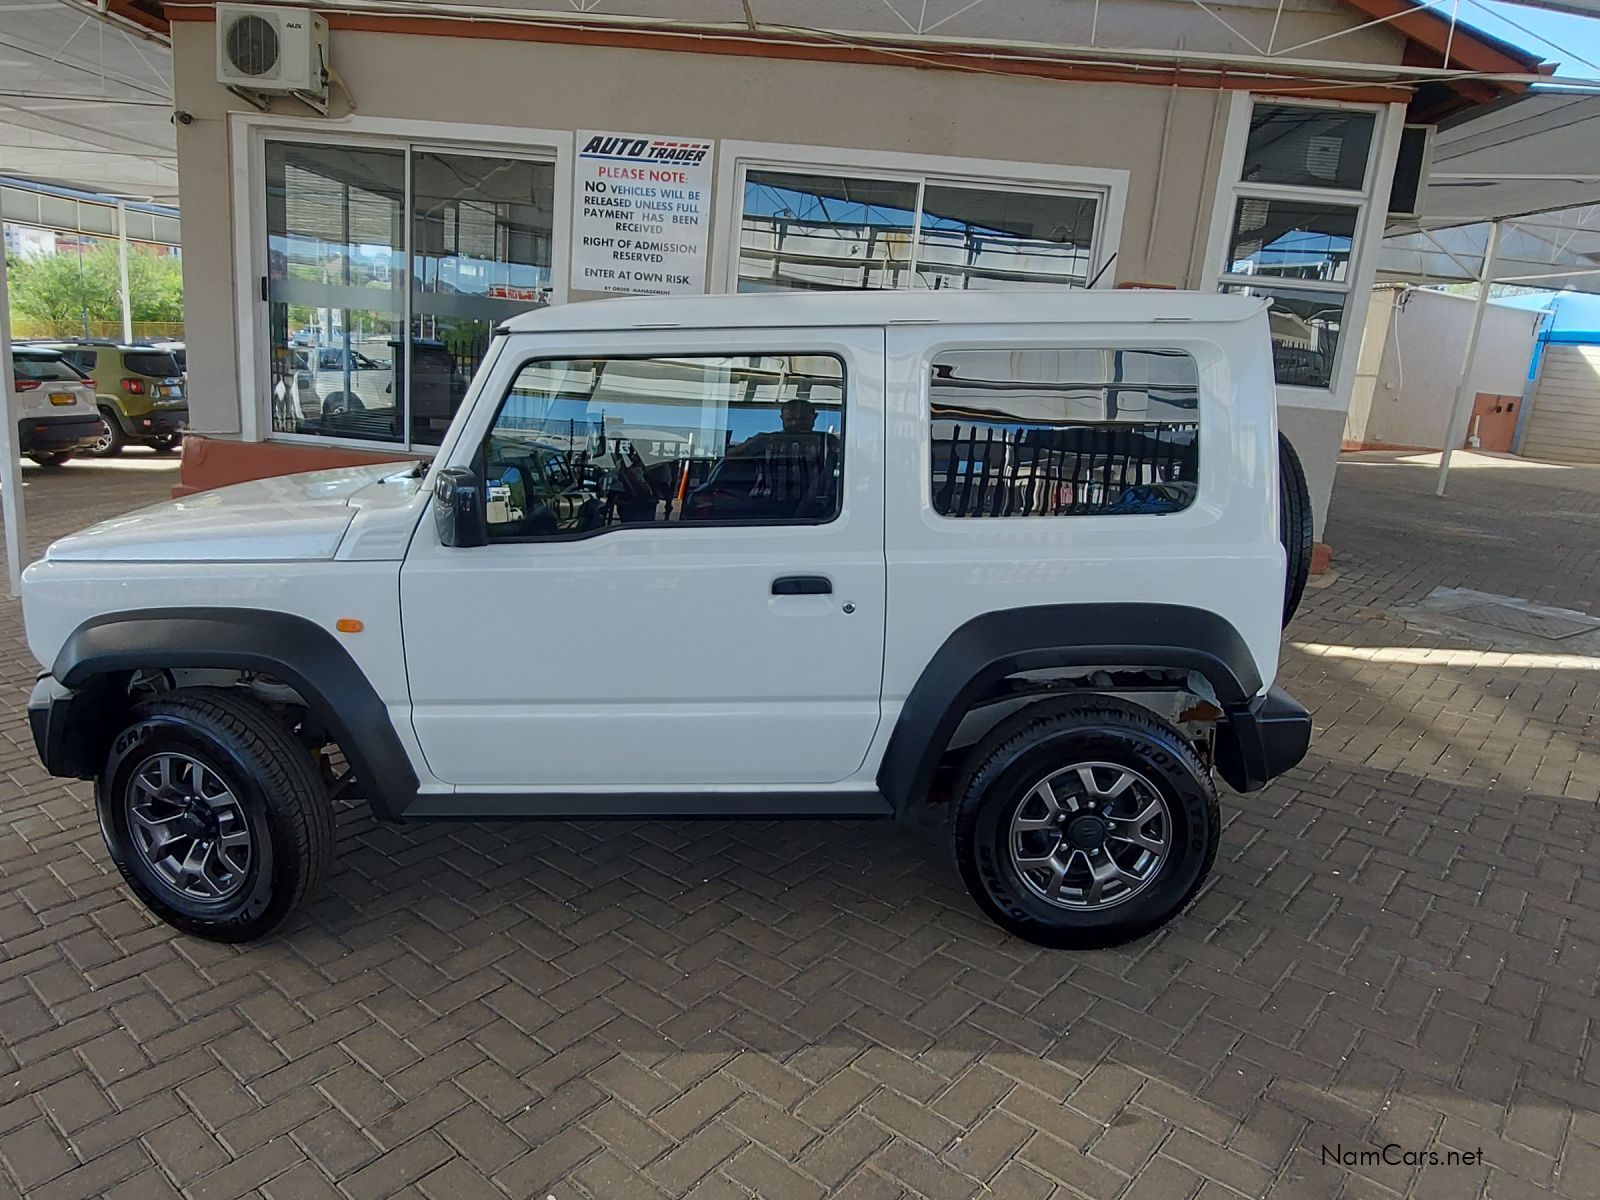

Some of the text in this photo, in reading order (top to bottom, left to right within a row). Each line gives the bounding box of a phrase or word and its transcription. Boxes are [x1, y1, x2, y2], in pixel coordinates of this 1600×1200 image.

[582, 136, 706, 162] AUTO TRADER
[598, 166, 688, 184] PLEASE NOTE:
[585, 181, 700, 200] NO VEHICLES WILL BE
[584, 196, 699, 213] RELEASED UNLESS FULL
[584, 208, 698, 225] PAYMENT HAS BEEN
[583, 236, 697, 254] RIGHT OF ADMISSION
[585, 268, 615, 279] ENTER
[618, 271, 631, 280] AT
[634, 272, 663, 283] OWN
